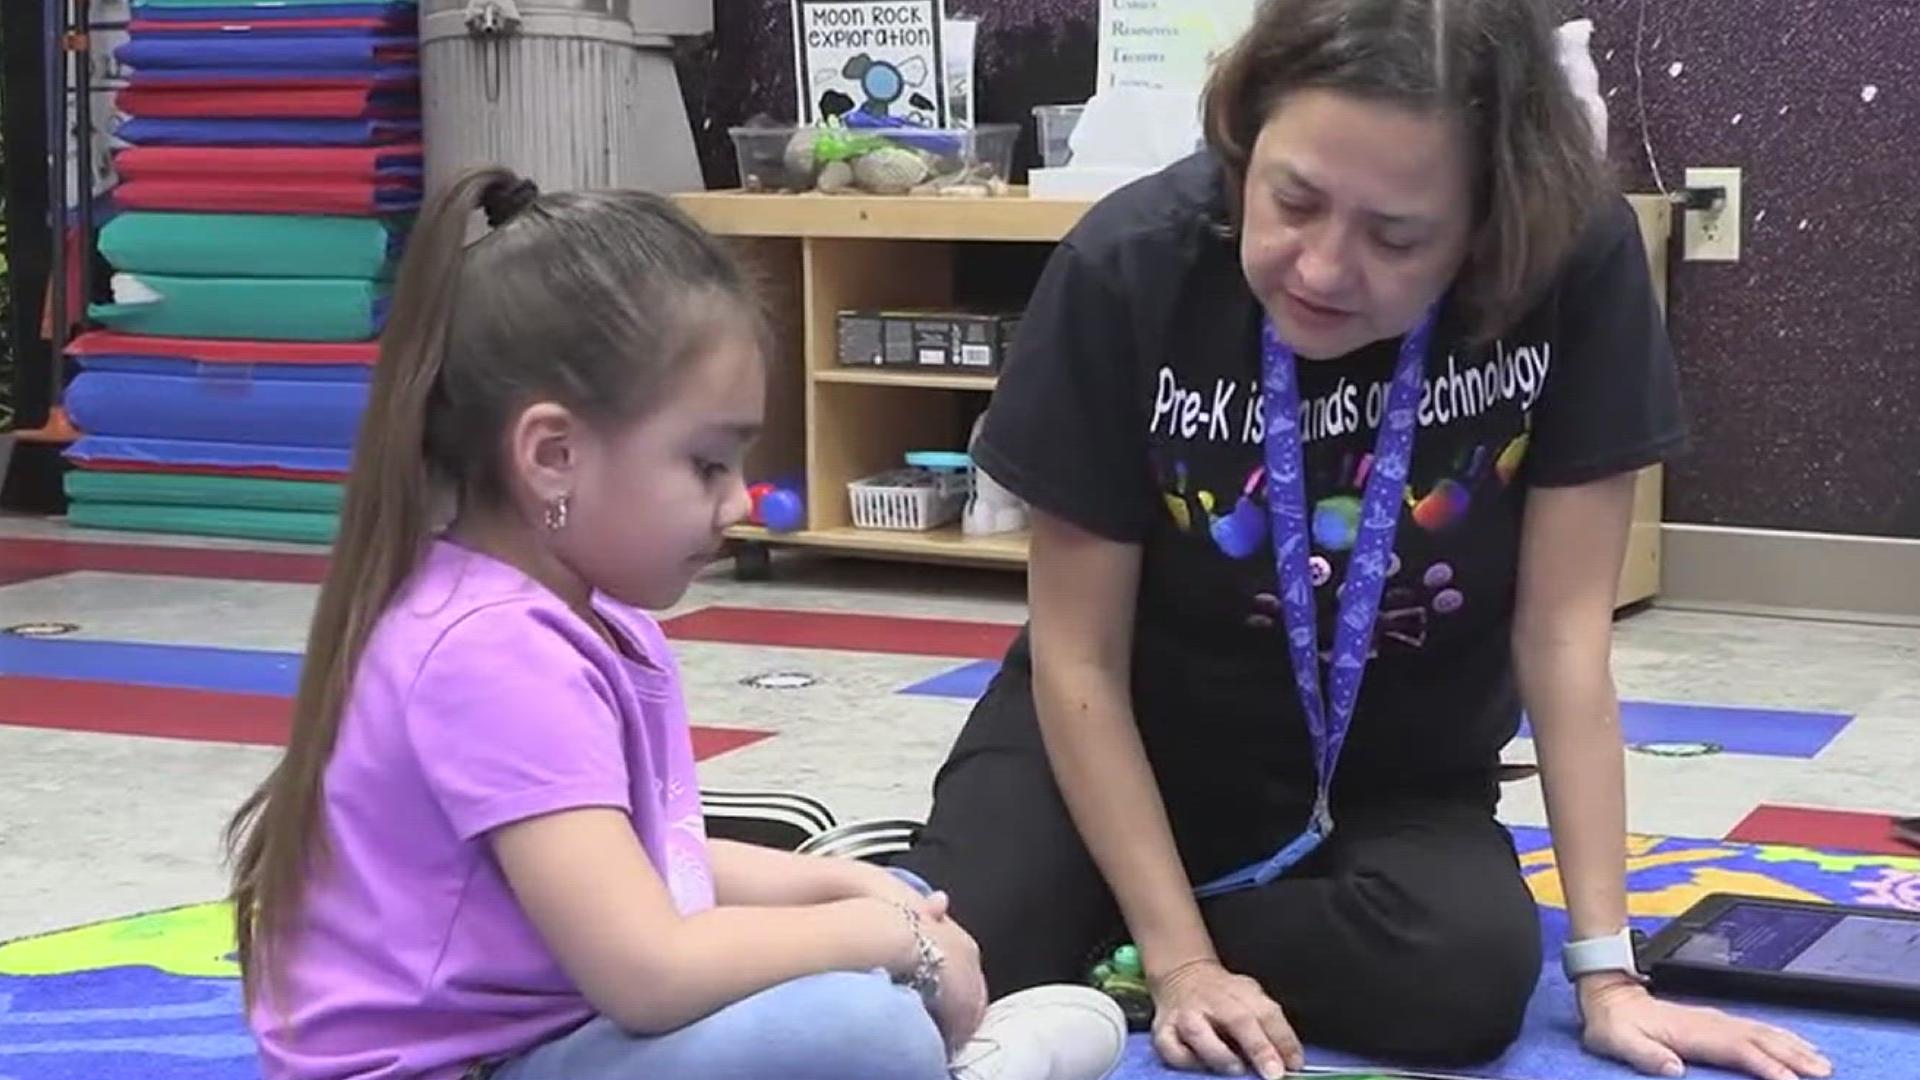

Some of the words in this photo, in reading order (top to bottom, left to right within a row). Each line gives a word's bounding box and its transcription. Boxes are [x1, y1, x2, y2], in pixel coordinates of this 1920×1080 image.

[1150, 367, 1236, 441] Pre-K
[1242, 381, 1266, 445] is
[1299, 377, 1357, 442] ands
[1418, 341, 1551, 427] echnology
